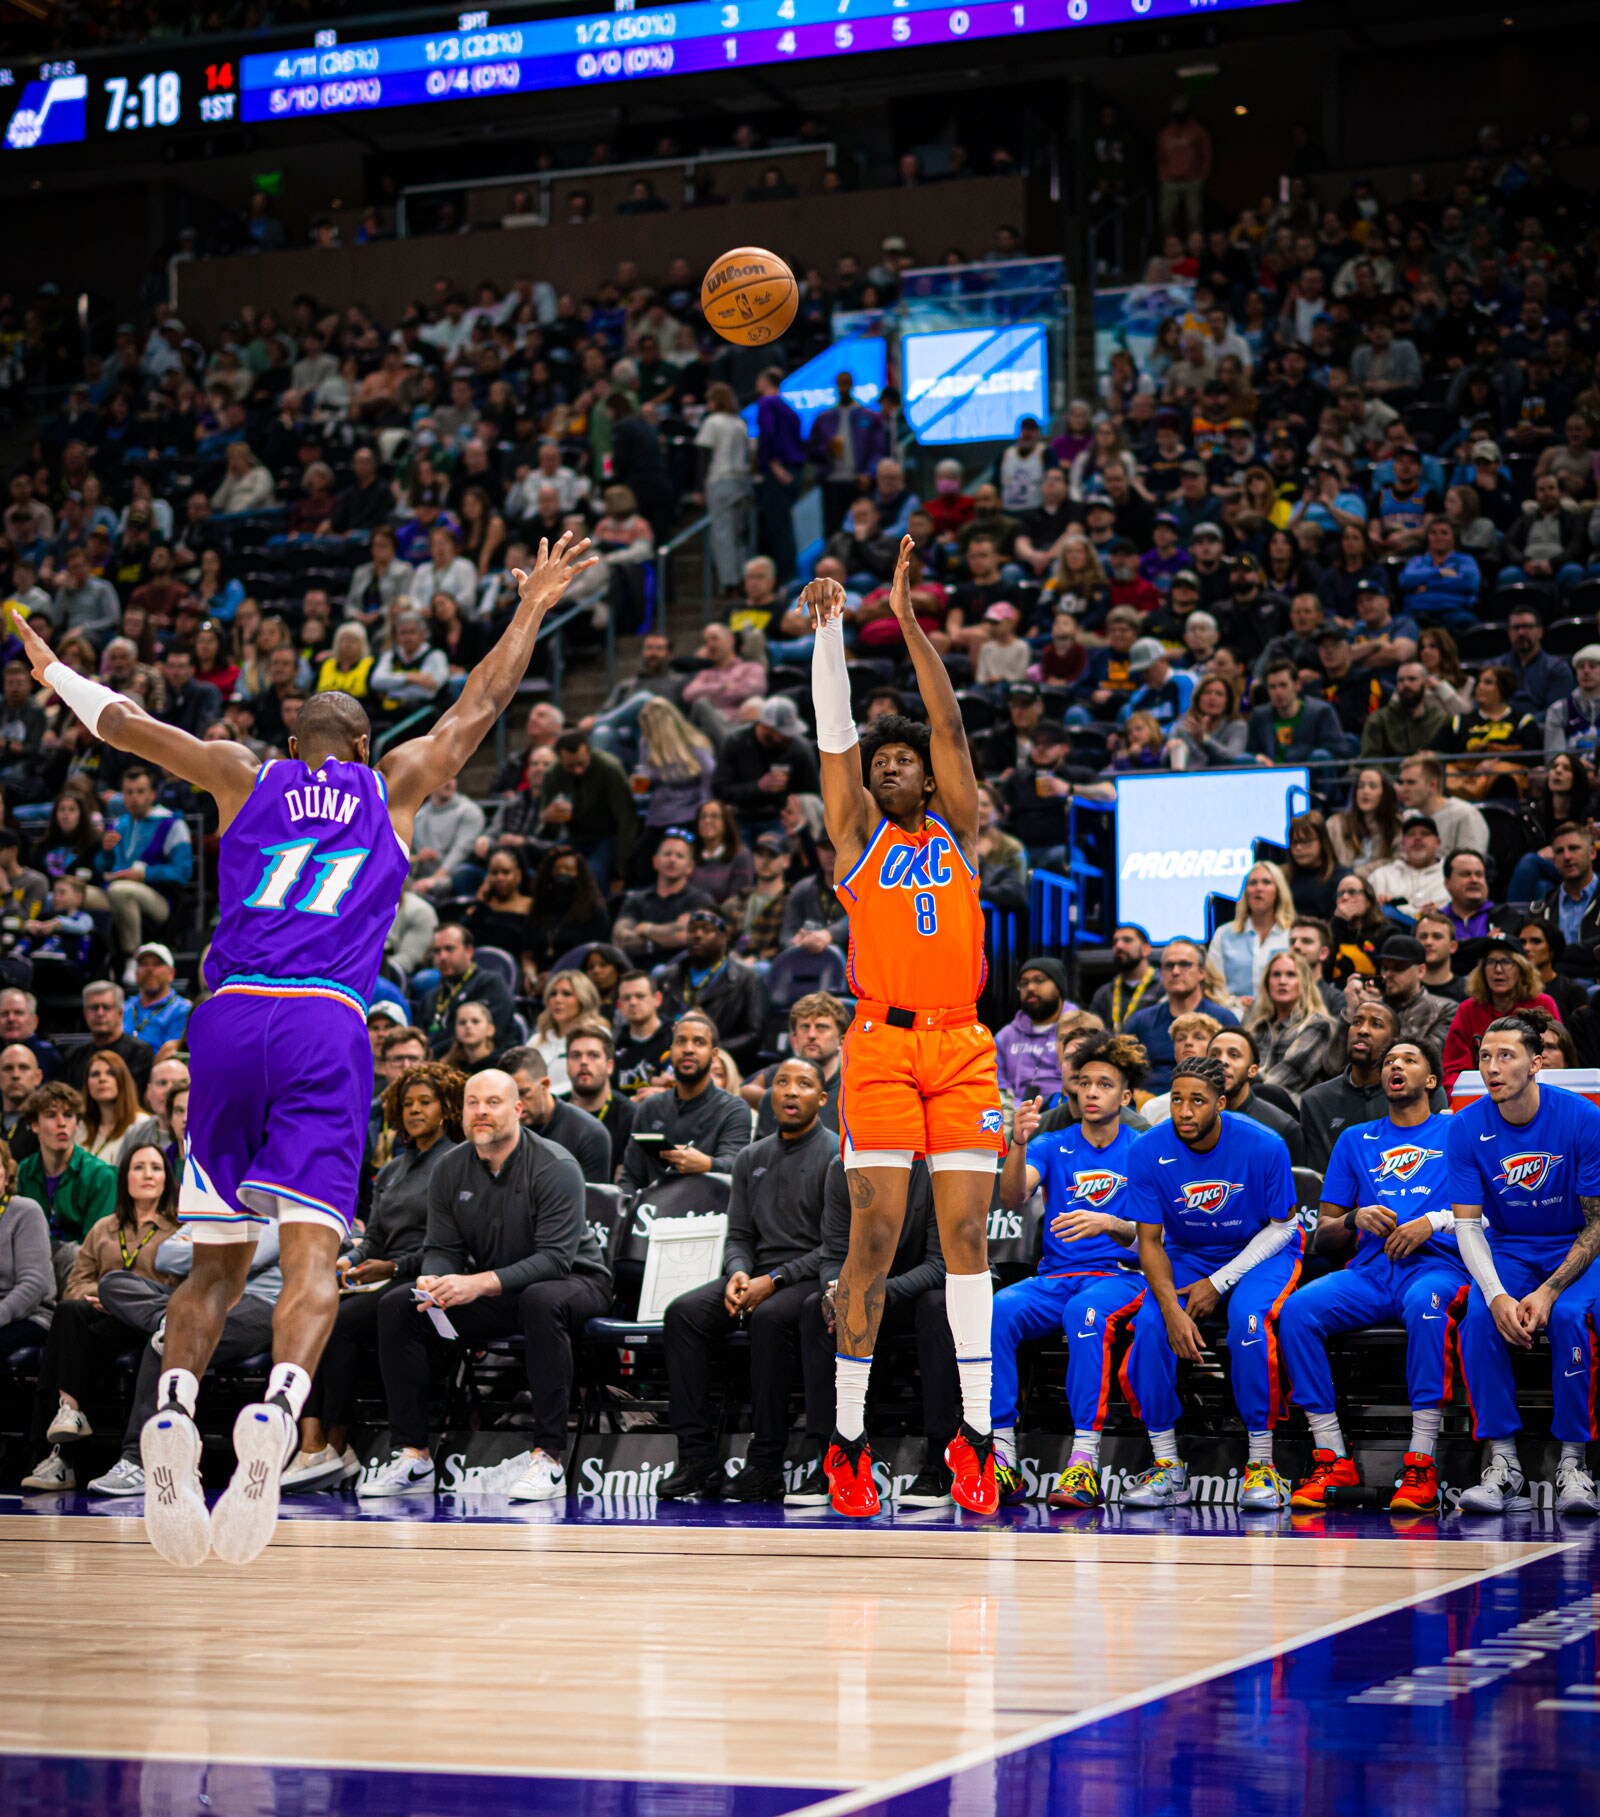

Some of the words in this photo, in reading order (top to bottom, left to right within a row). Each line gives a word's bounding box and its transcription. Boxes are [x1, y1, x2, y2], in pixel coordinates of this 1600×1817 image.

[425, 38, 459, 62] 1/3
[576, 21, 611, 44] 1/2
[613, 13, 676, 42] (50%)
[721, 5, 739, 28] 3
[269, 85, 319, 113] 5/10
[426, 68, 469, 95] 0/4
[471, 61, 520, 93] (0%)
[576, 50, 622, 78] 0/0
[624, 44, 674, 76] (0%)
[723, 37, 738, 62] 1
[776, 31, 797, 54] 4
[834, 23, 854, 48] 5
[892, 16, 911, 42] 5
[949, 9, 970, 35] 0
[1010, 4, 1025, 28] 1
[205, 62, 234, 91] 14
[104, 70, 181, 131] 7:18
[199, 94, 237, 122] 1ST
[707, 265, 767, 294] Wilson
[284, 785, 360, 825] DUNN
[242, 837, 370, 917] 11
[879, 837, 952, 889] OKC
[914, 892, 938, 936] 8
[983, 1114, 1000, 1128] OKC
[1381, 1150, 1419, 1177] OKC
[1507, 1156, 1541, 1185] OKC
[1074, 1176, 1112, 1199] OKC
[1187, 1185, 1220, 1208] OKC
[986, 1209, 1022, 1239] th's
[577, 1458, 675, 1496] Smit
